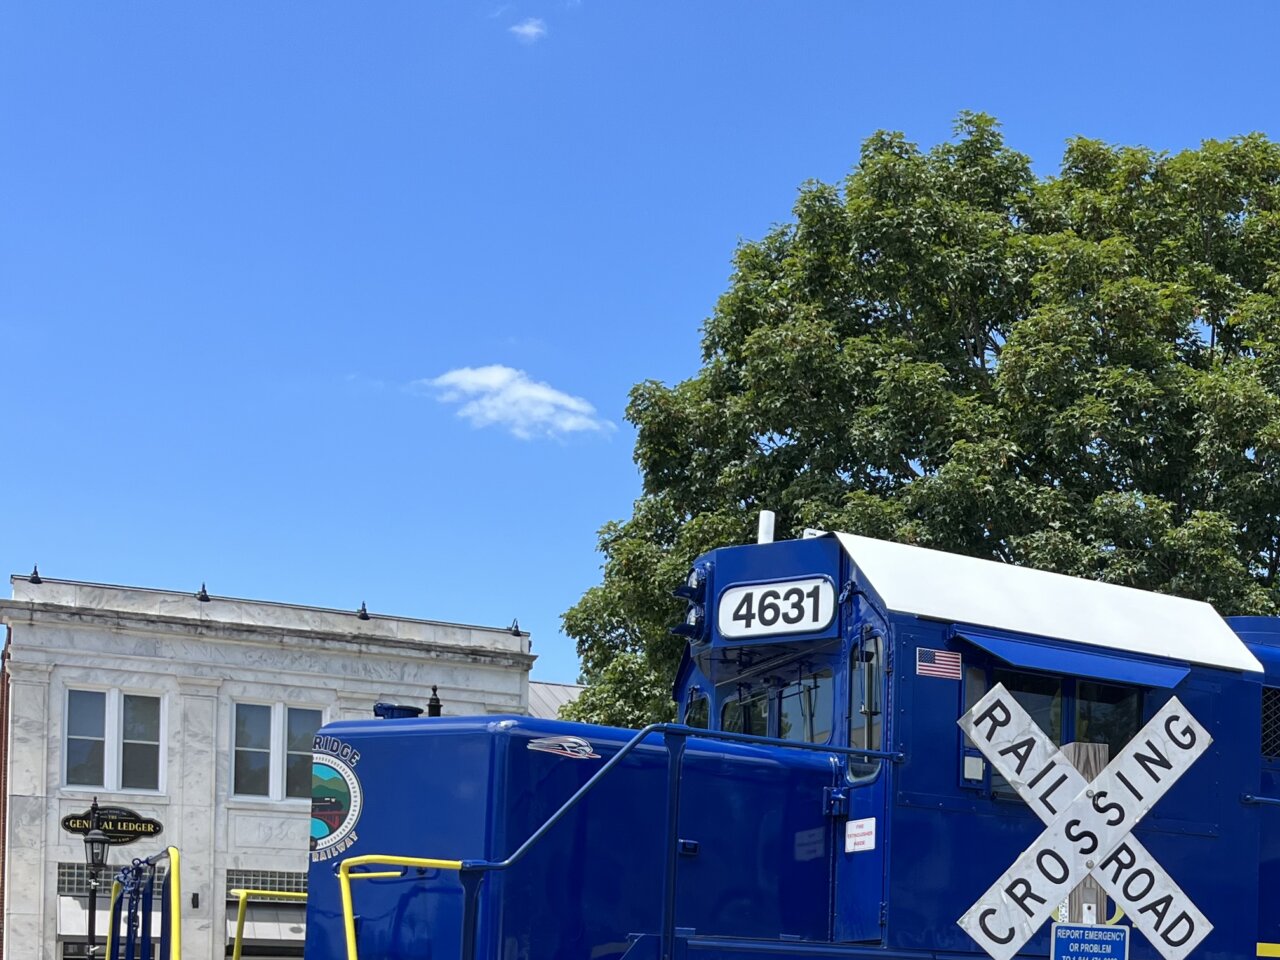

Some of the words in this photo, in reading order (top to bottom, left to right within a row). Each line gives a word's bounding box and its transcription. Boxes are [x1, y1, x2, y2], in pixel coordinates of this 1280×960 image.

[732, 585, 820, 628] 4631
[312, 735, 360, 767] RIDGE
[69, 820, 114, 830] GENAL
[118, 822, 154, 832] LEDGER
[973, 698, 1069, 815] RAIL
[1099, 842, 1195, 948] ROAD
[978, 714, 1197, 945] CROSSING
[312, 830, 358, 862] RAILWAY
[1057, 929, 1083, 939] REPORT
[1085, 930, 1125, 941] EMERGENCY
[1069, 943, 1079, 952] OR
[1080, 943, 1112, 953] PROBLEM
